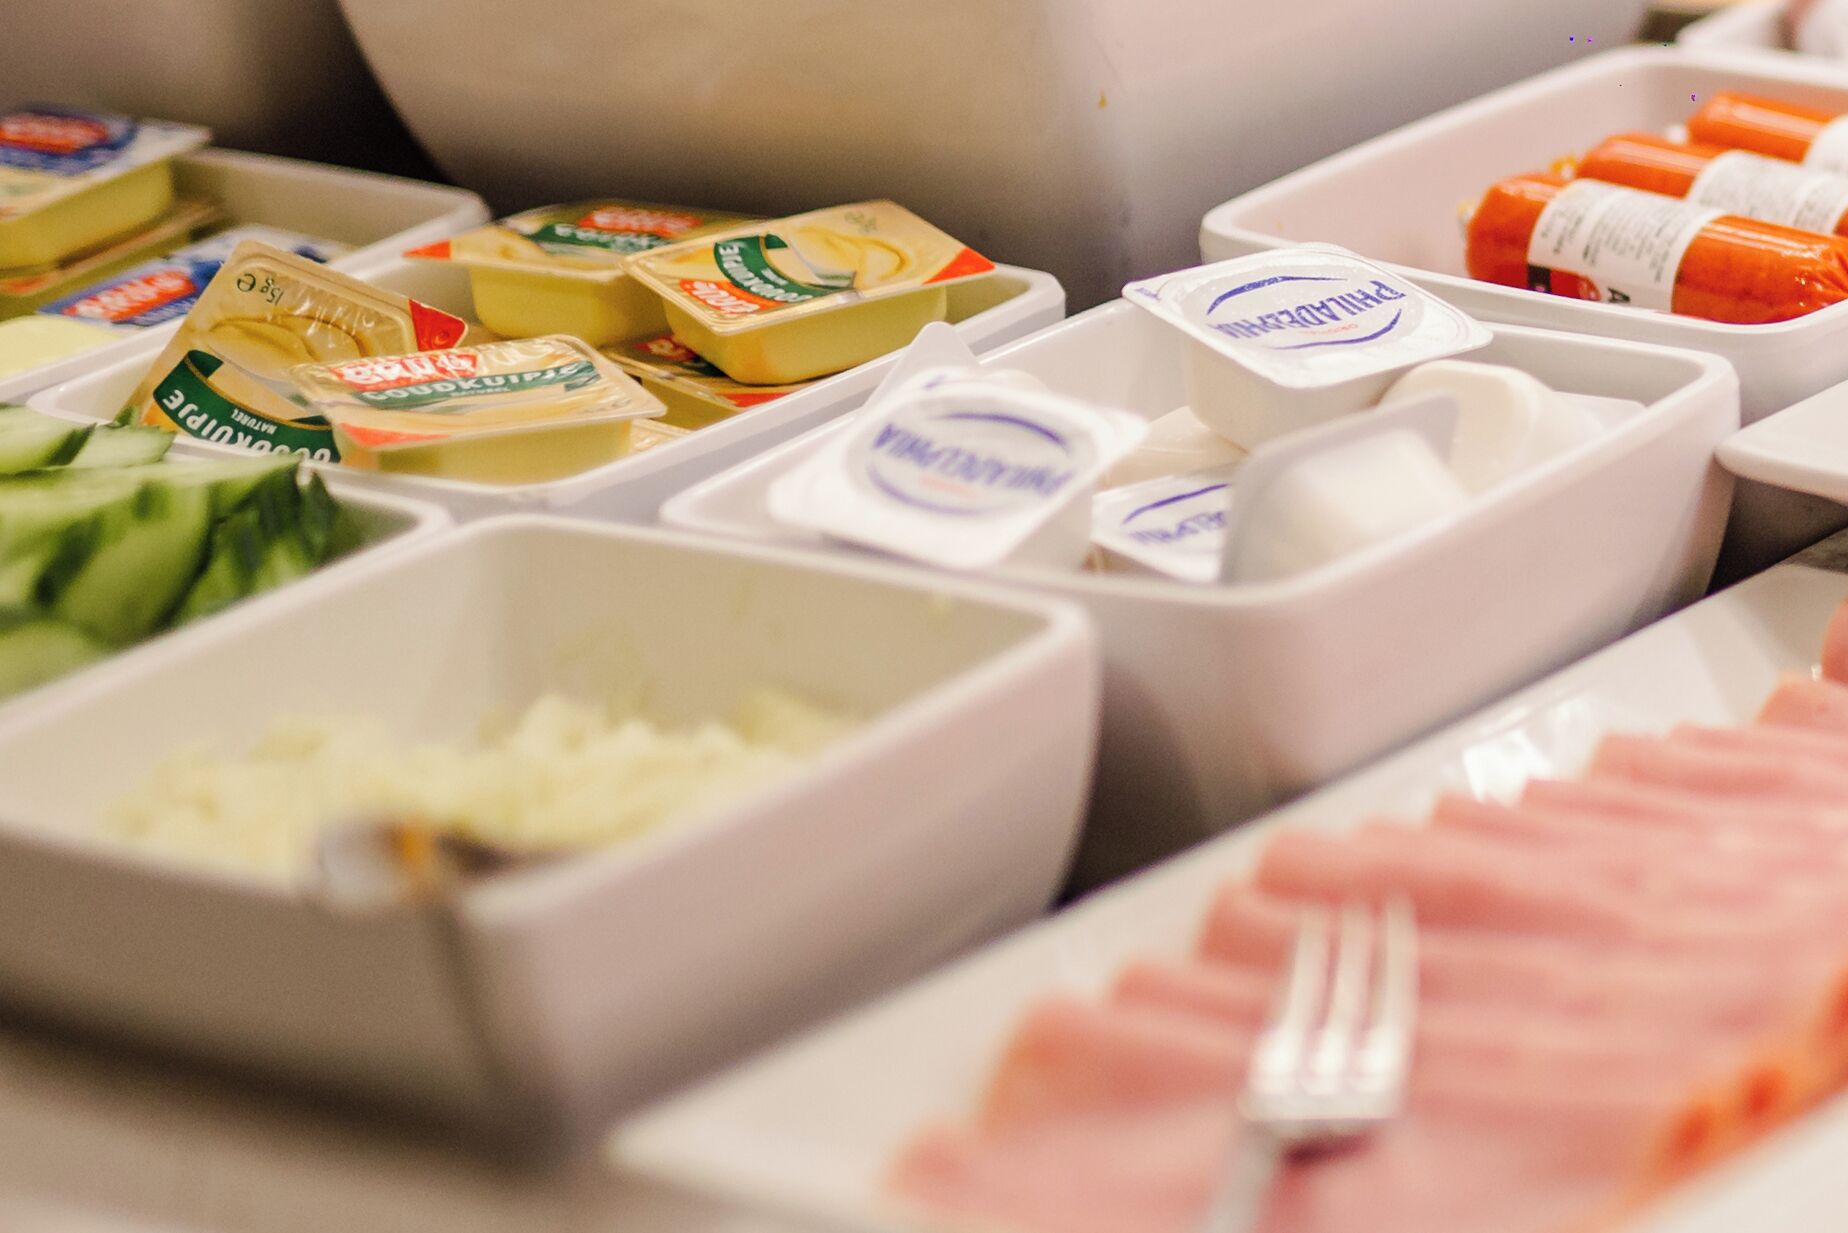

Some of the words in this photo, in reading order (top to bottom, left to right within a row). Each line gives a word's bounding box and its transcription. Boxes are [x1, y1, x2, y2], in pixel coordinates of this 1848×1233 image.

[1206, 279, 1407, 339] PHILADELPHIA
[359, 362, 584, 402] GOUDKUIPJE
[231, 408, 278, 436] NATUREL
